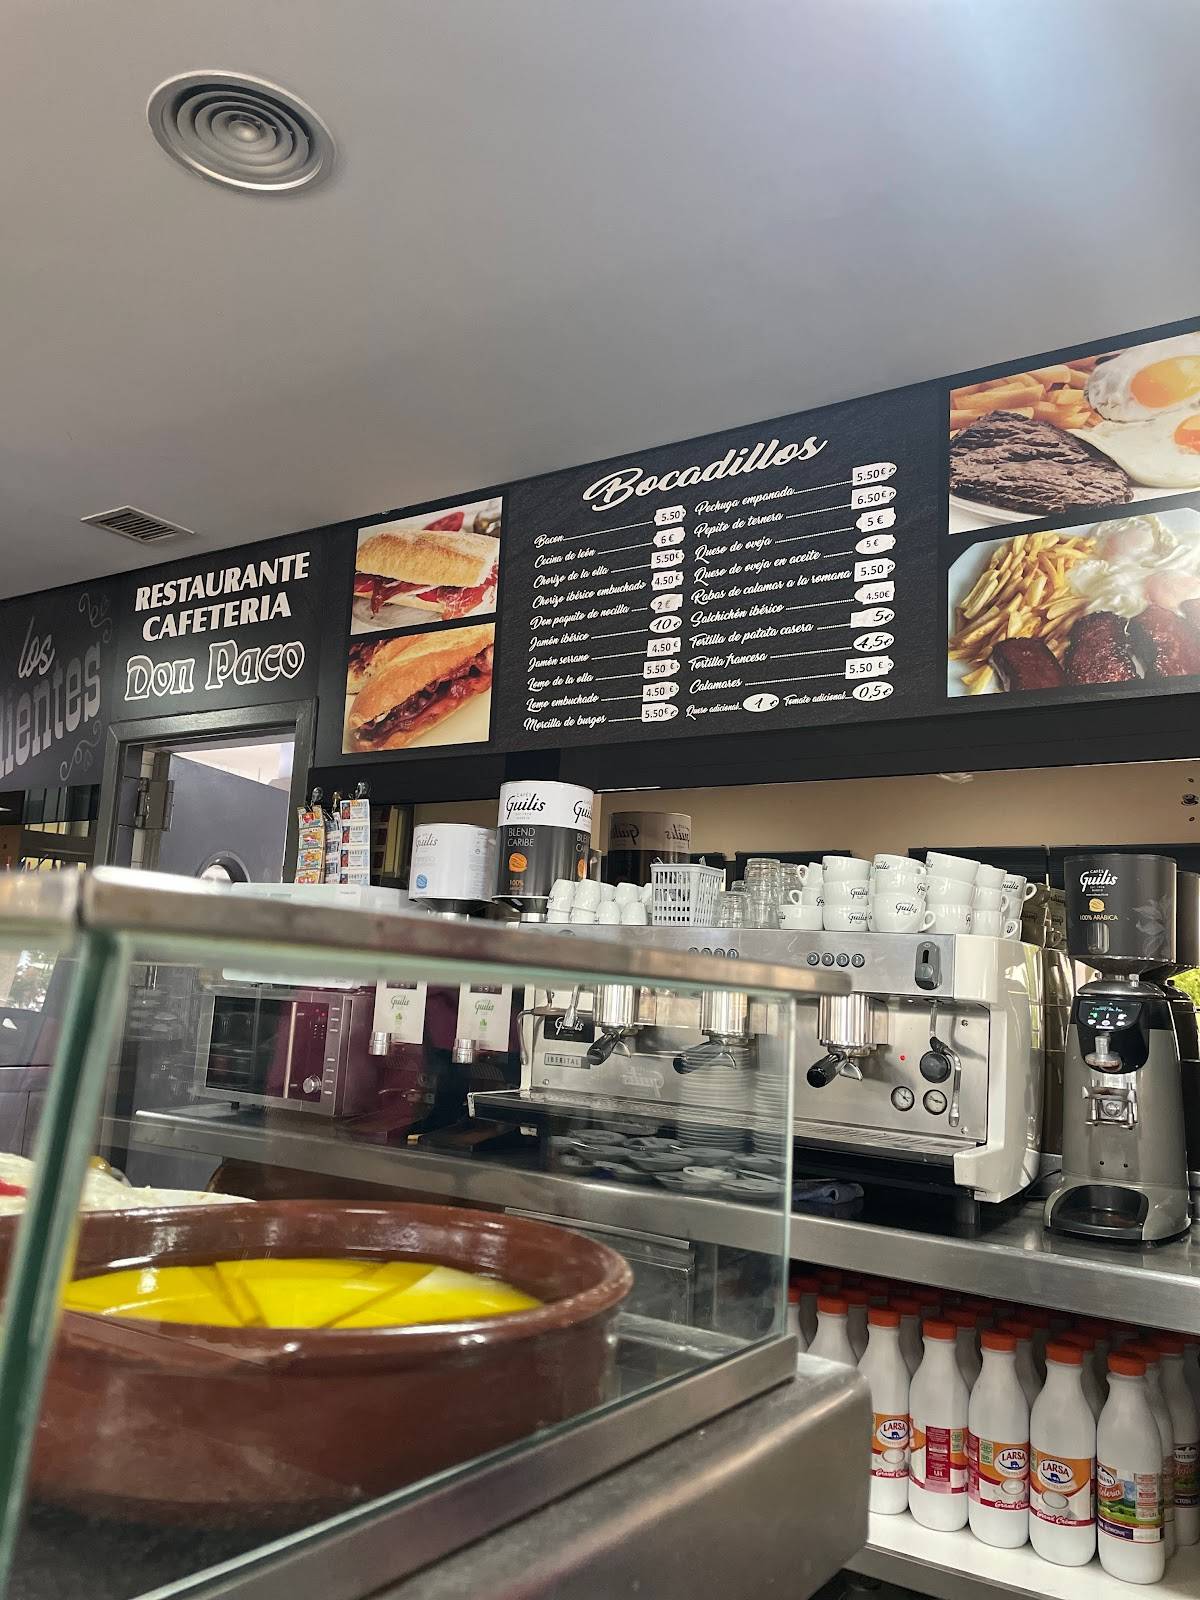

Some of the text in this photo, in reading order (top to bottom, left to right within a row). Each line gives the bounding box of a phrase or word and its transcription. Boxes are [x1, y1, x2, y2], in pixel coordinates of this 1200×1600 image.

[583, 436, 828, 511] Bocadillos
[694, 486, 795, 516] Pechuga empanada
[661, 510, 681, 522] 5.50
[693, 511, 783, 539] Pepito de ternera
[867, 517, 874, 527] 5
[534, 534, 564, 548] Bacon
[694, 536, 772, 564] Queso de oveja
[534, 547, 595, 568] Cecina de león
[533, 566, 609, 588] Chorizo de la olla
[694, 550, 821, 587] Queso de oveja en aceite
[135, 552, 311, 612] RESTAURANTE
[691, 570, 852, 605] Rabas de calamar a la romana
[532, 581, 647, 609] Chorizo ibérico embuchado
[142, 591, 292, 642] CAFETERIA
[530, 604, 630, 630] Don paquito de nocilla
[690, 603, 784, 627] Salchichón ibérico
[529, 632, 590, 652] Jamón ibérico
[689, 621, 814, 649] Tortilla de patata casera
[18, 616, 55, 678] los
[125, 639, 305, 701] Don Paco
[528, 654, 590, 672] Jamón serrano
[688, 652, 768, 671] Tortilla francesa
[527, 673, 594, 692] Lomo de la olla
[689, 678, 742, 694] Calamares
[526, 692, 600, 713] Lomo embuchado
[783, 691, 846, 706] Tomate adicional
[0, 642, 101, 779] ientes
[685, 702, 740, 720] Queso adicional
[523, 714, 607, 731] Morcilla de burgos
[506, 793, 546, 820] Guilis
[507, 838, 534, 847] CARIBE
[508, 828, 536, 837] BLEND
[1080, 869, 1118, 892] Guilis
[883, 1422, 906, 1432] LARSA
[1002, 1450, 1026, 1462] LARSA
[1042, 1462, 1070, 1478] LARSA
